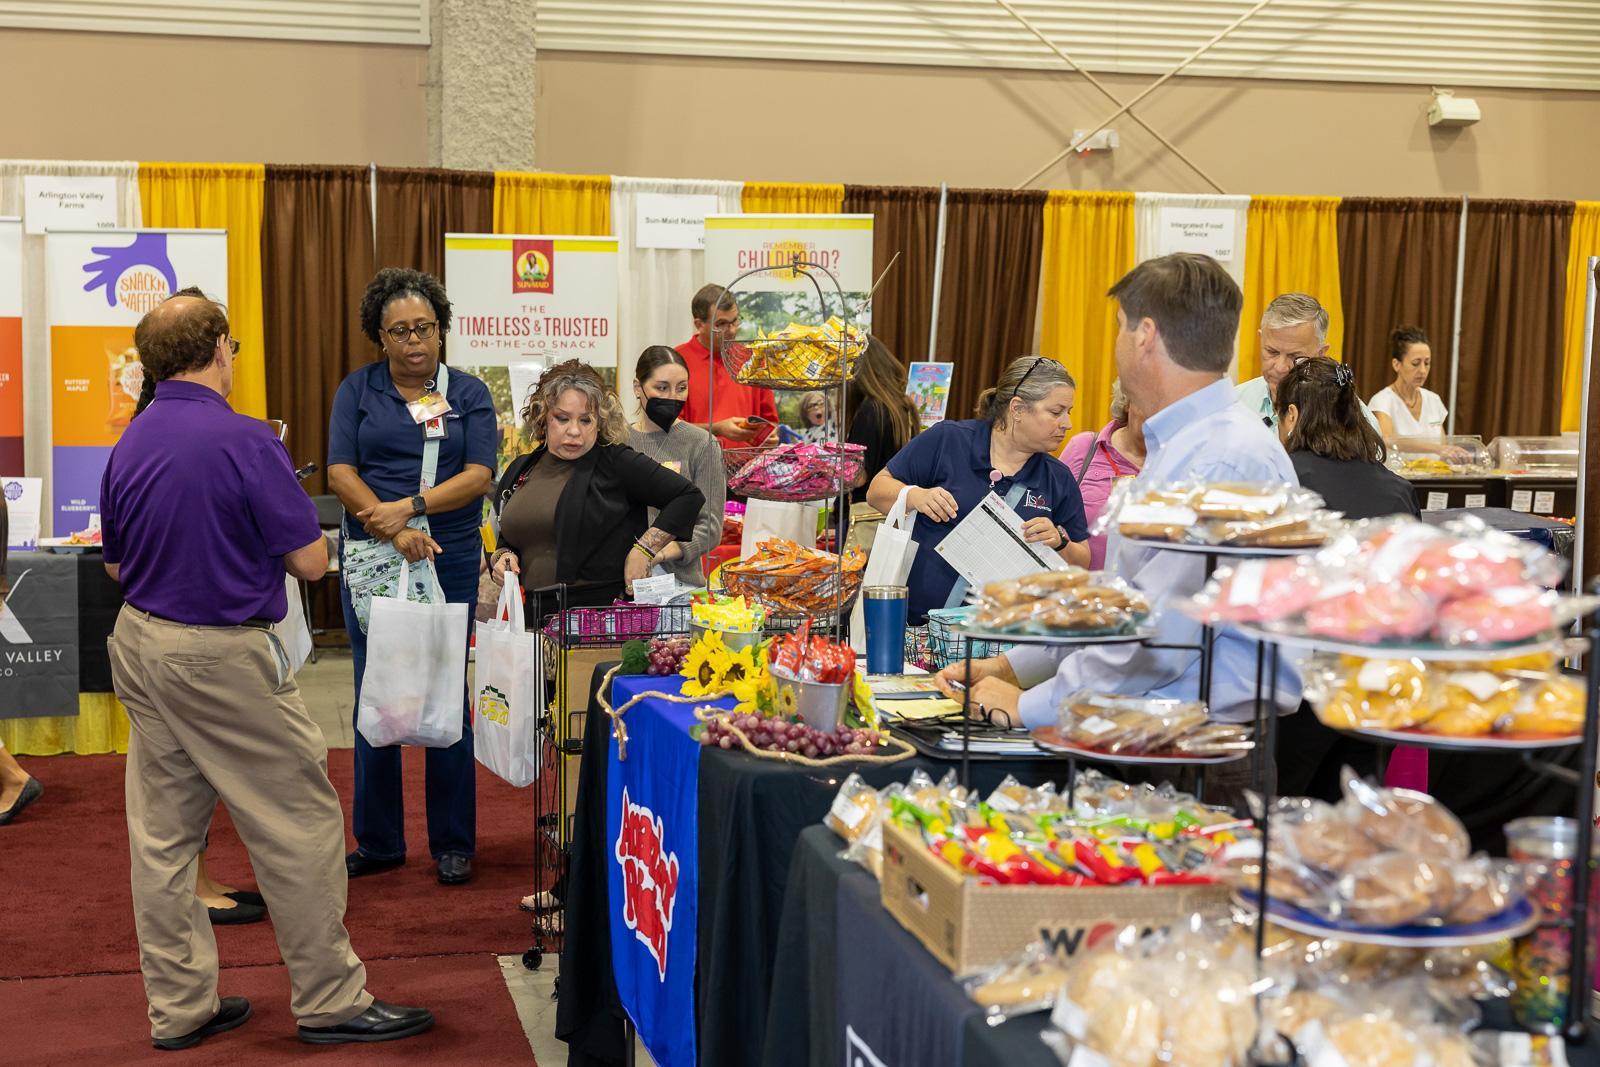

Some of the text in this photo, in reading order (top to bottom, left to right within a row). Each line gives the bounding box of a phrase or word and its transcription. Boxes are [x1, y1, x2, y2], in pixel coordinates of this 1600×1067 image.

[39, 191, 104, 201] Arlington Valley
[58, 201, 85, 209] Farms
[737, 249, 840, 269] CHILDHOOD?
[521, 305, 546, 313] THE
[457, 316, 609, 337] TIMELESS & TRUSTED
[470, 339, 596, 349] ON-THE-GO SNACK
[5, 649, 63, 665] VALLEY
